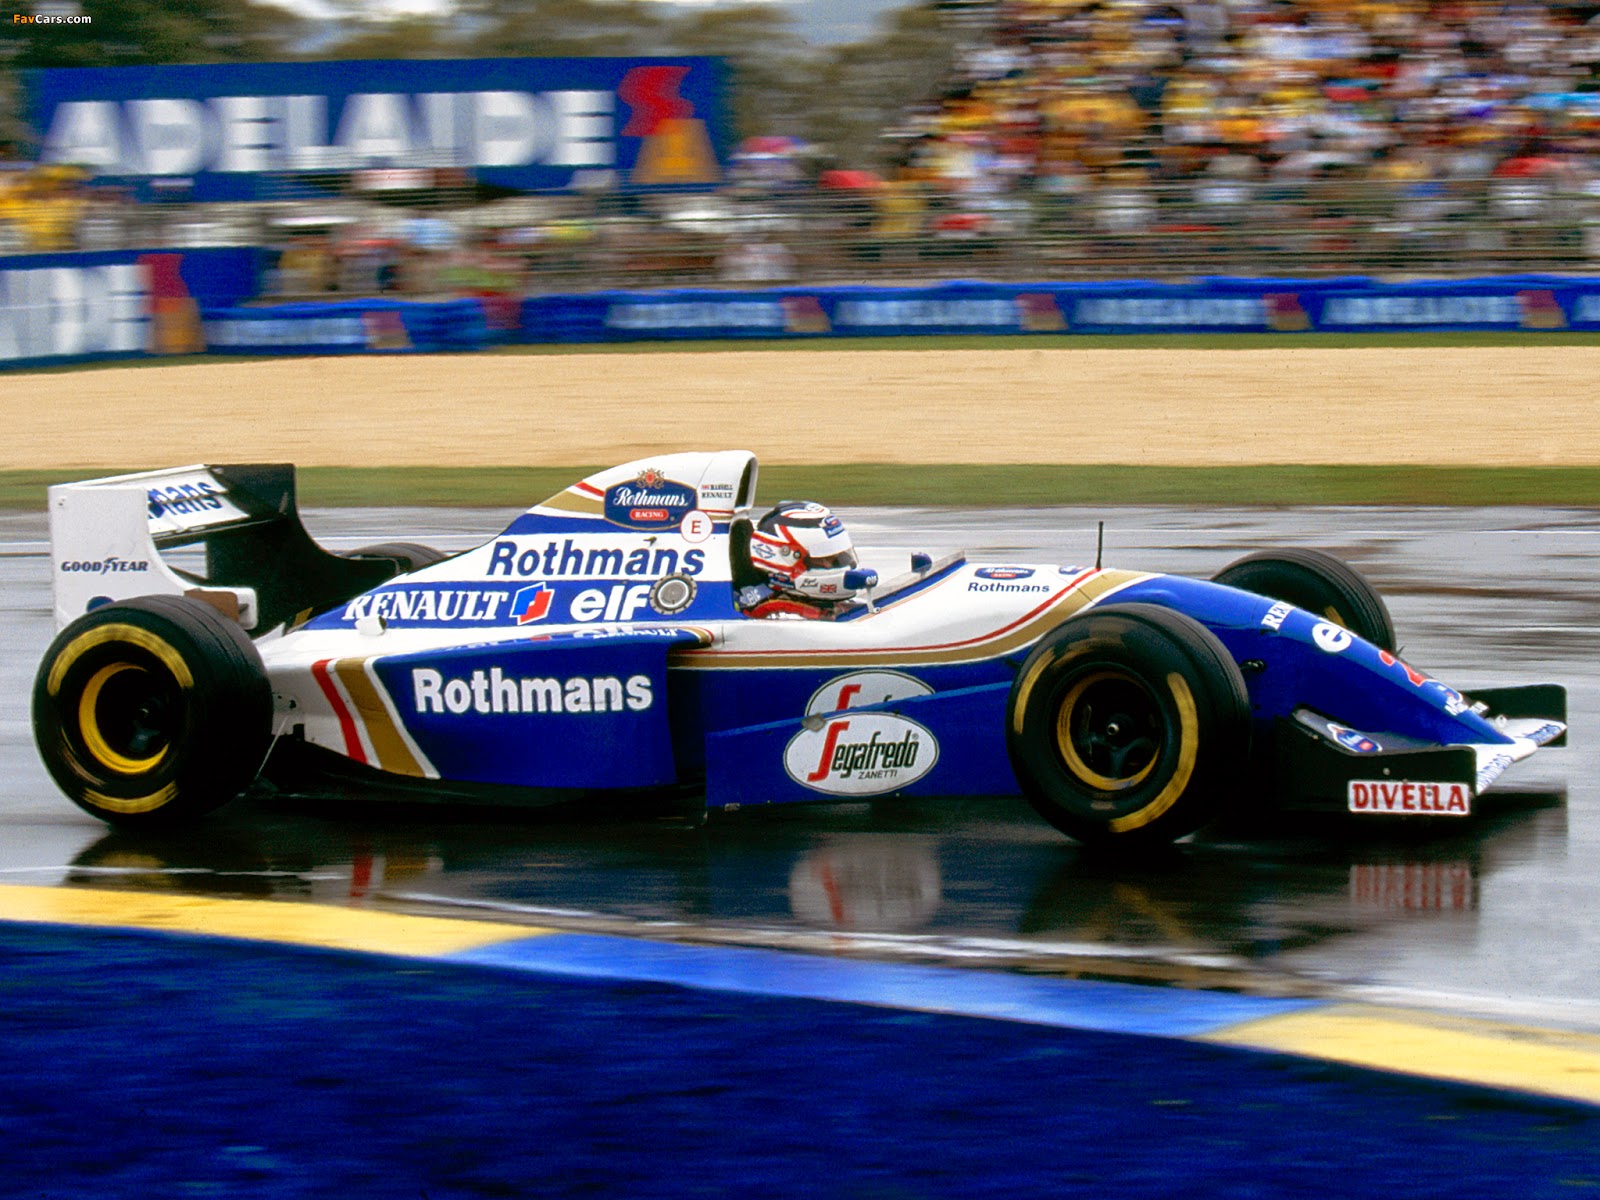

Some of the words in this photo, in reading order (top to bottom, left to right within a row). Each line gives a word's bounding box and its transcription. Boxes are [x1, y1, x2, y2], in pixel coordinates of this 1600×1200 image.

[44, 90, 615, 174] ADELAIDE
[613, 486, 688, 506] Rothmans
[701, 491, 733, 499] RENAULT
[691, 520, 701, 534] E
[61, 557, 148, 575] GOODYEAR
[487, 540, 704, 577] Rothmans
[968, 582, 1050, 592] Rothmans
[342, 590, 509, 620] RENAULT
[570, 586, 650, 622] elf
[412, 667, 653, 714] Rothmans
[807, 721, 919, 782] Segafredo
[858, 769, 898, 780] ZANETTI
[1352, 783, 1466, 812] DIVELLA
